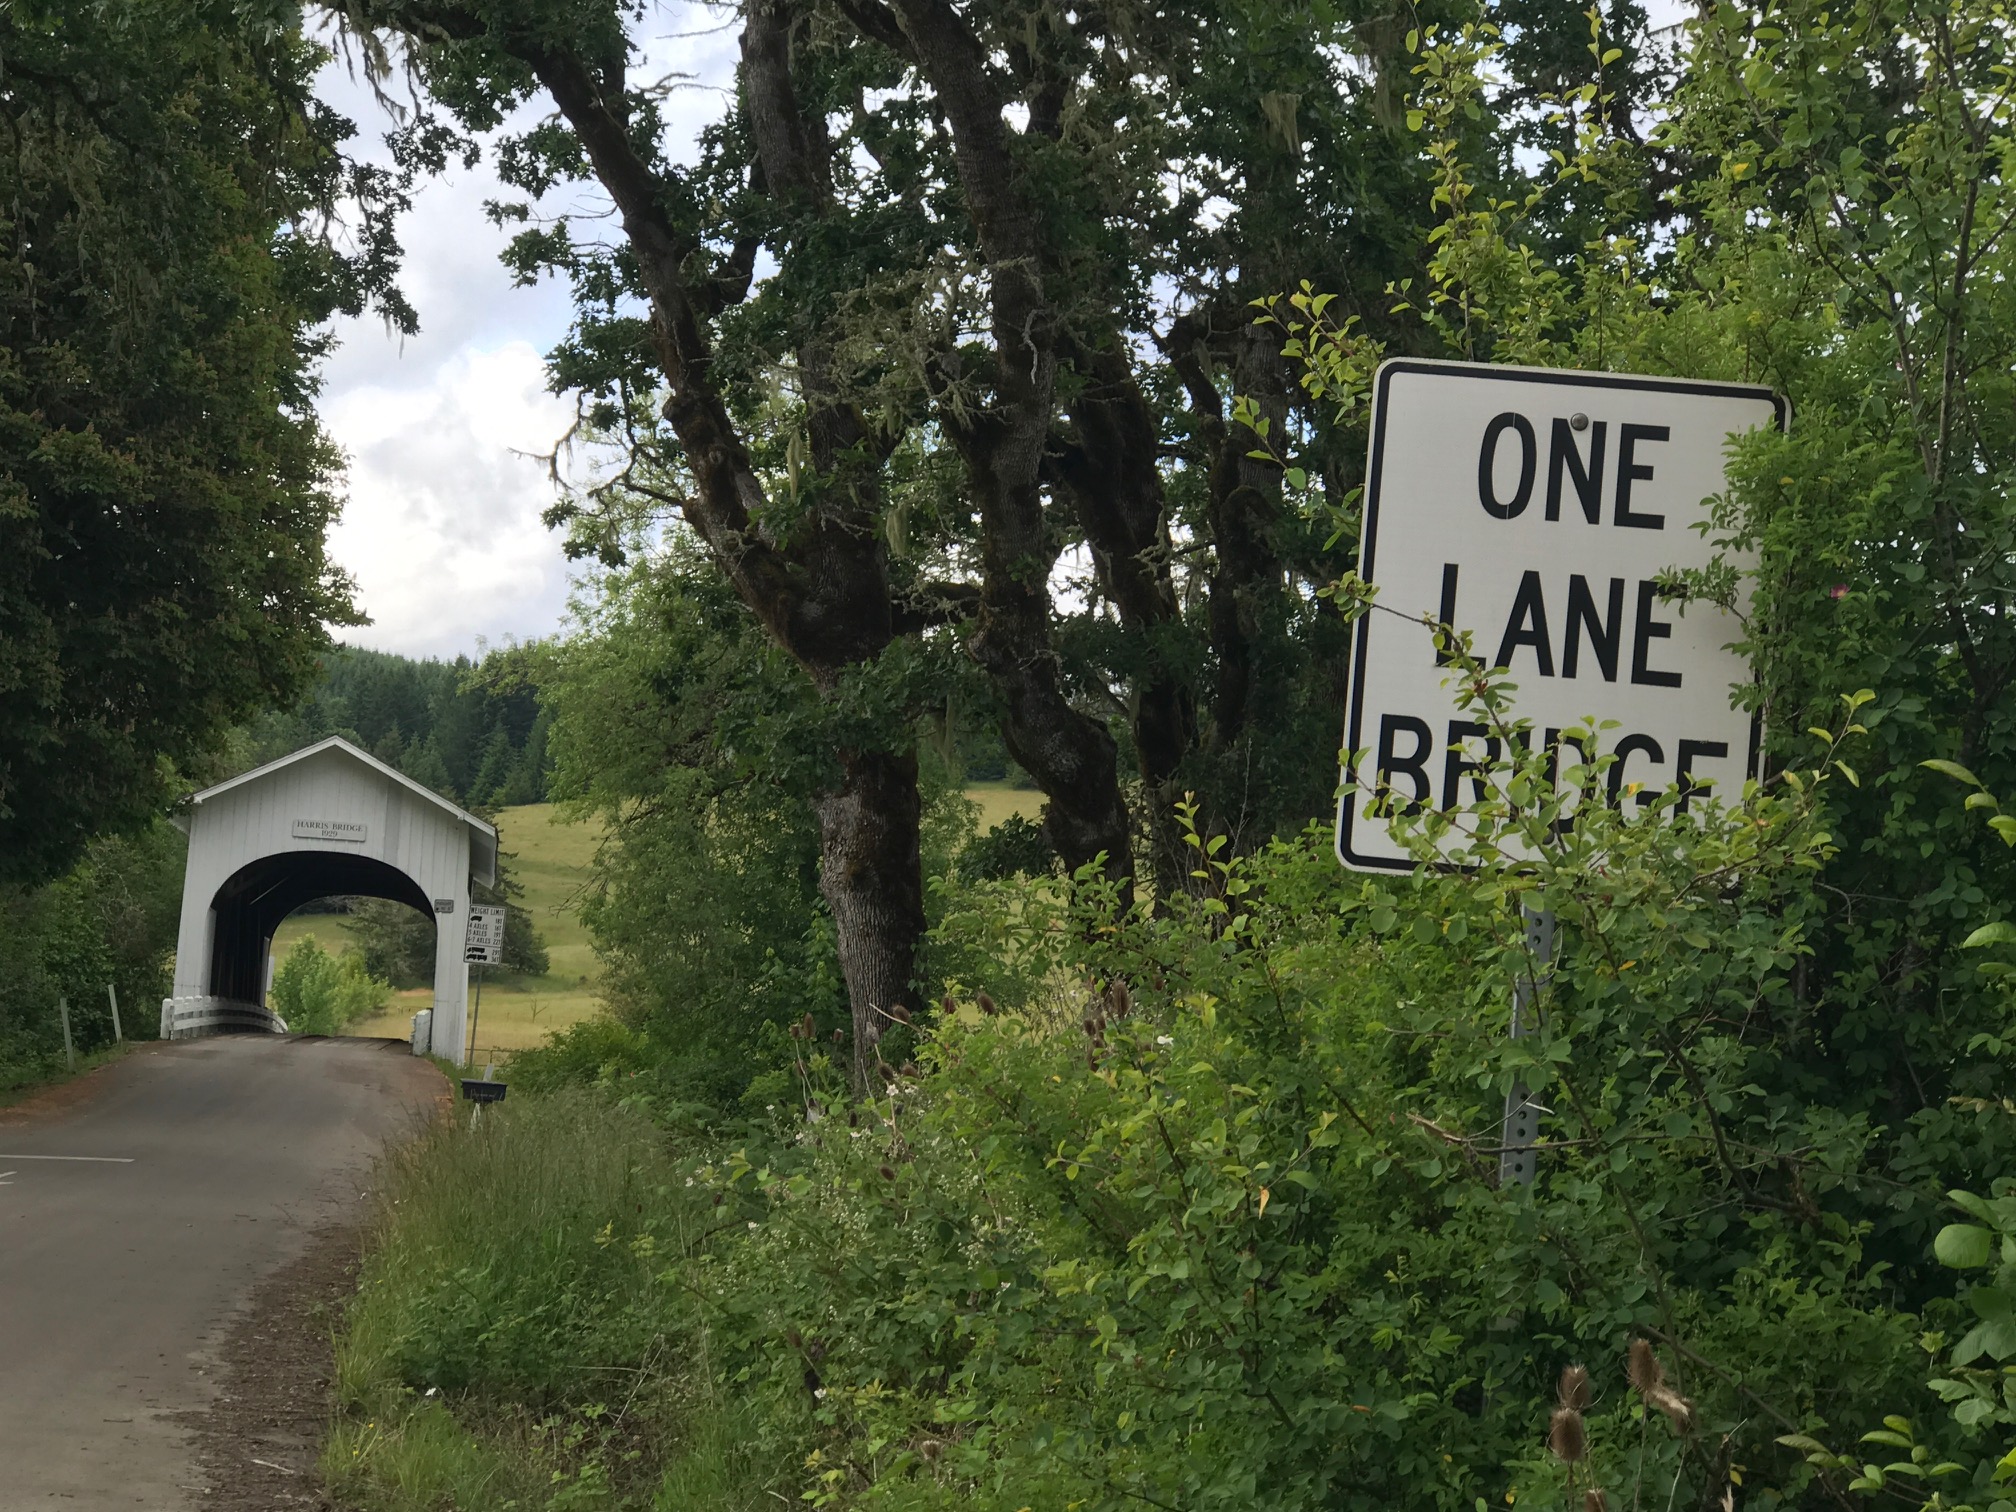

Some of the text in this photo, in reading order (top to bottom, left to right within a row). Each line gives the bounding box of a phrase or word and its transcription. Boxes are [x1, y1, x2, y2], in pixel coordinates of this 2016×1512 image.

[1478, 412, 1670, 530] ONE
[1436, 563, 1687, 688] LANE
[296, 820, 363, 832] HARRIS BRIDGE
[321, 829, 338, 838] 1929
[470, 907, 489, 916] WEIGHT
